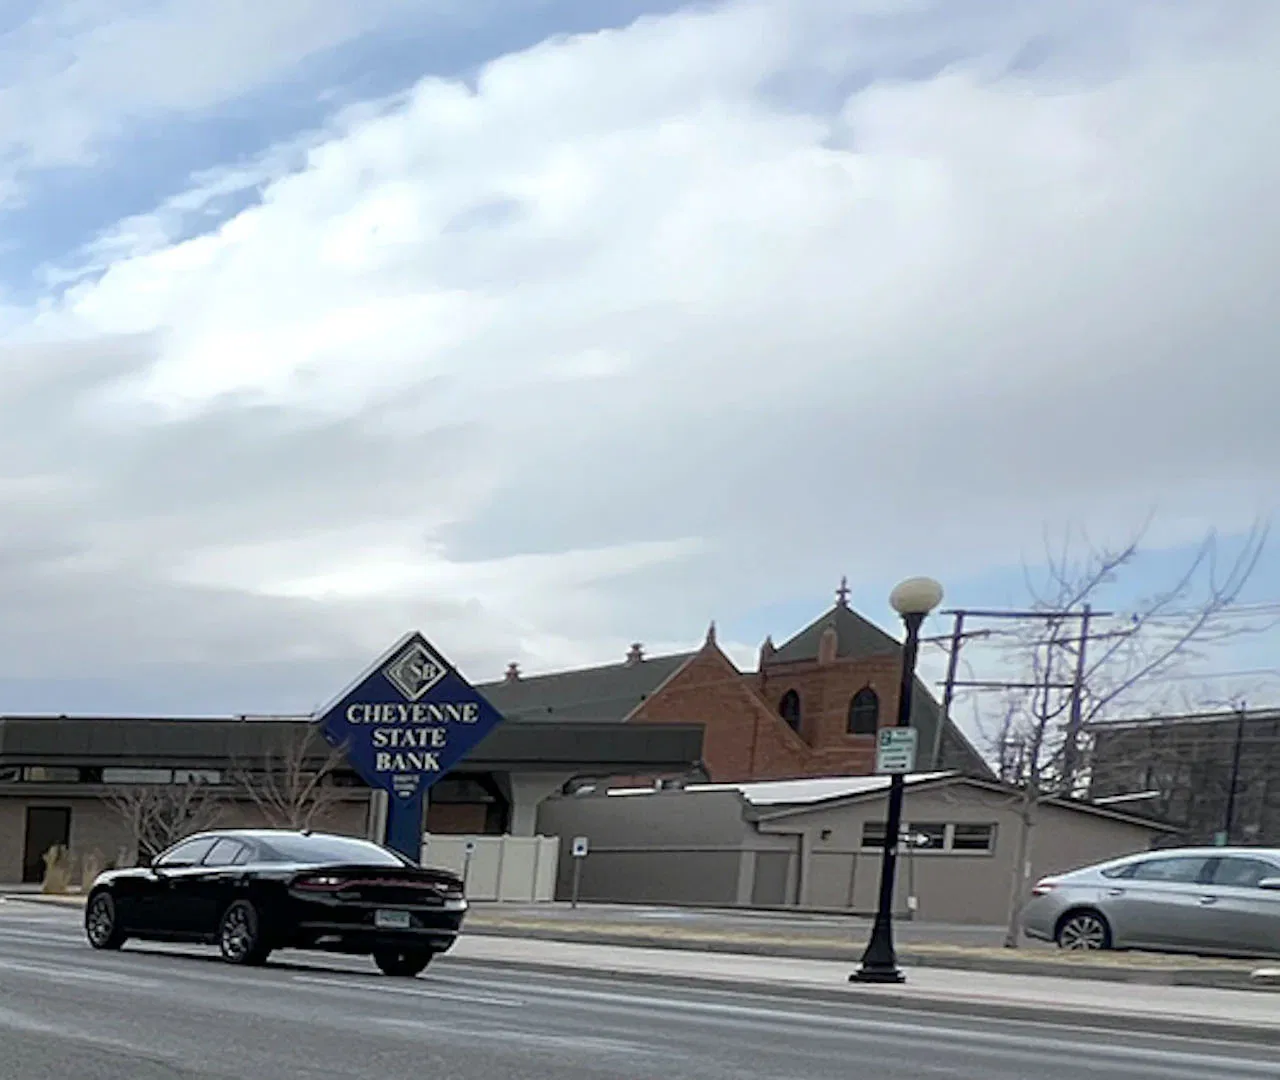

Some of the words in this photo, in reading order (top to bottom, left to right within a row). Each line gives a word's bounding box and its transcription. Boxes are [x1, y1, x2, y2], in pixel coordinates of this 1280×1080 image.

[347, 704, 478, 723] CHEYENNE
[372, 727, 446, 748] STATE
[376, 752, 440, 772] BANK
